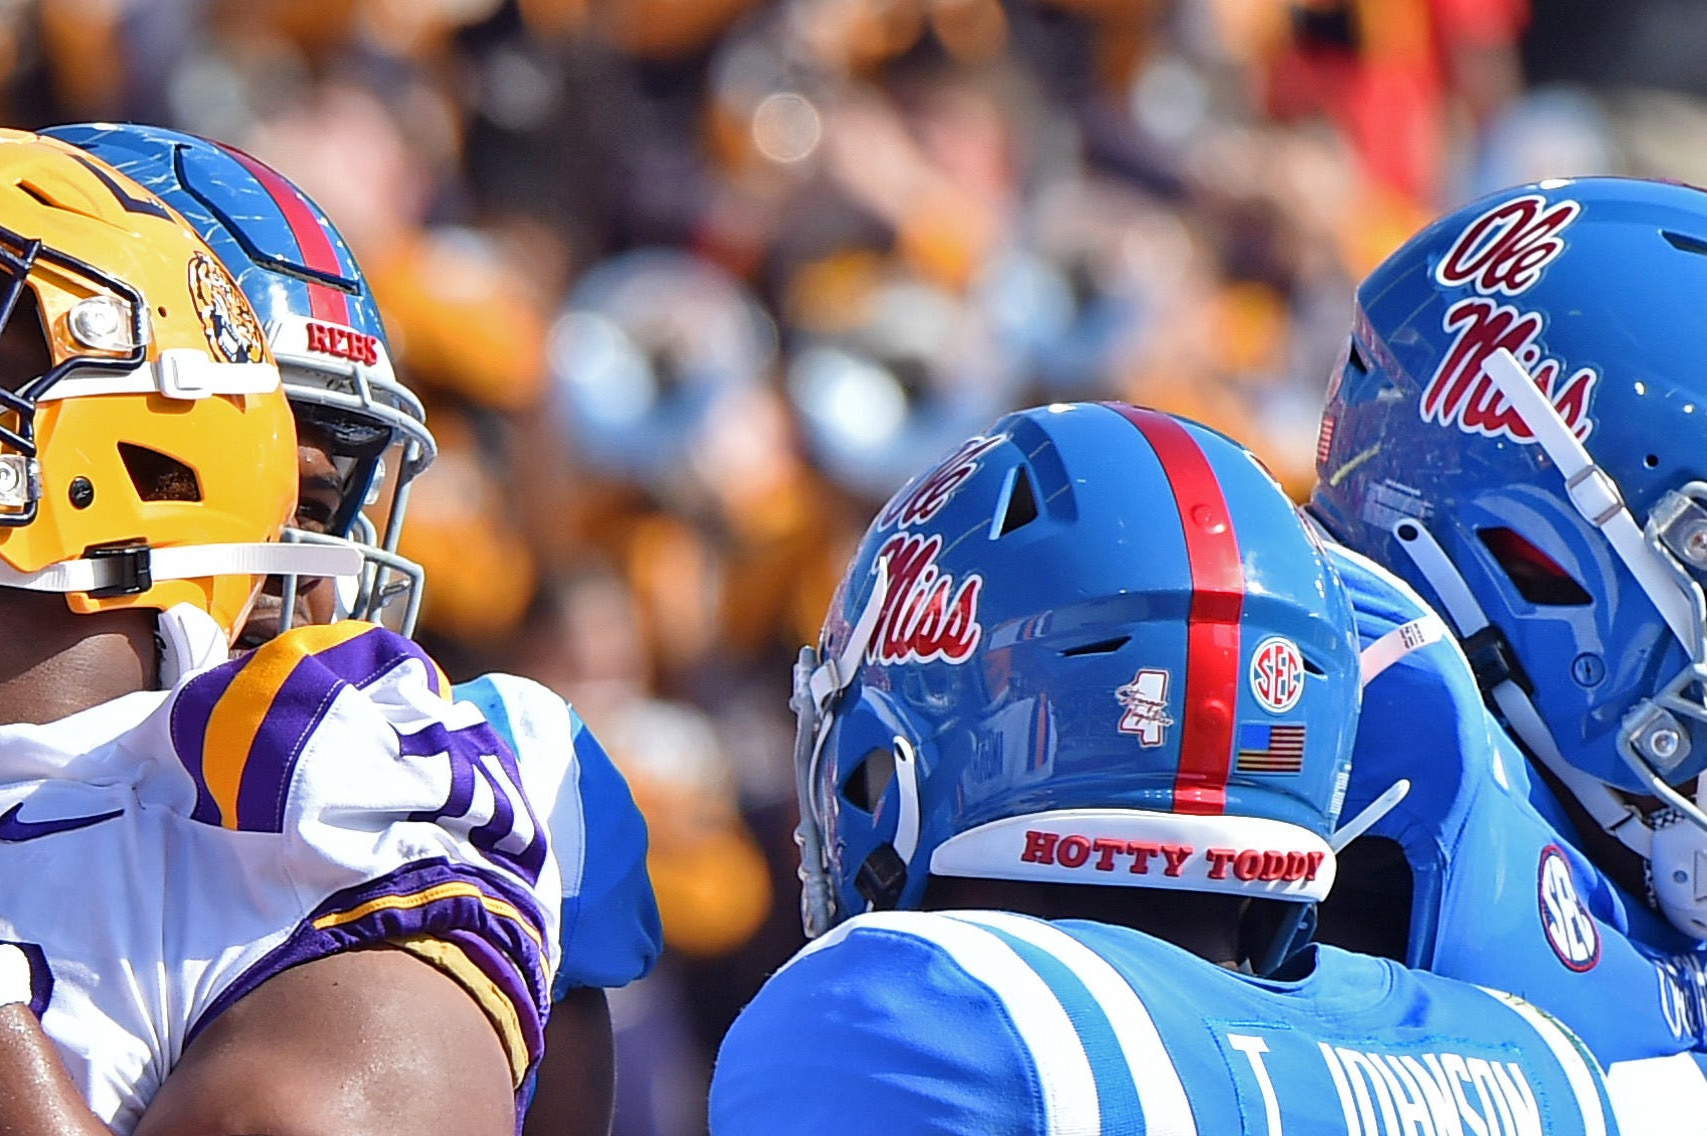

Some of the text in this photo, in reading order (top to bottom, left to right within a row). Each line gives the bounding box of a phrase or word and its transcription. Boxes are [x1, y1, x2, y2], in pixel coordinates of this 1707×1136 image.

[1436, 195, 1580, 294] Ole
[306, 322, 377, 367] REBS
[867, 531, 982, 665] Miss
[1254, 643, 1299, 706] SEC
[1021, 830, 1325, 882] HOTTY TODDY
[1541, 853, 1597, 962] SEC
